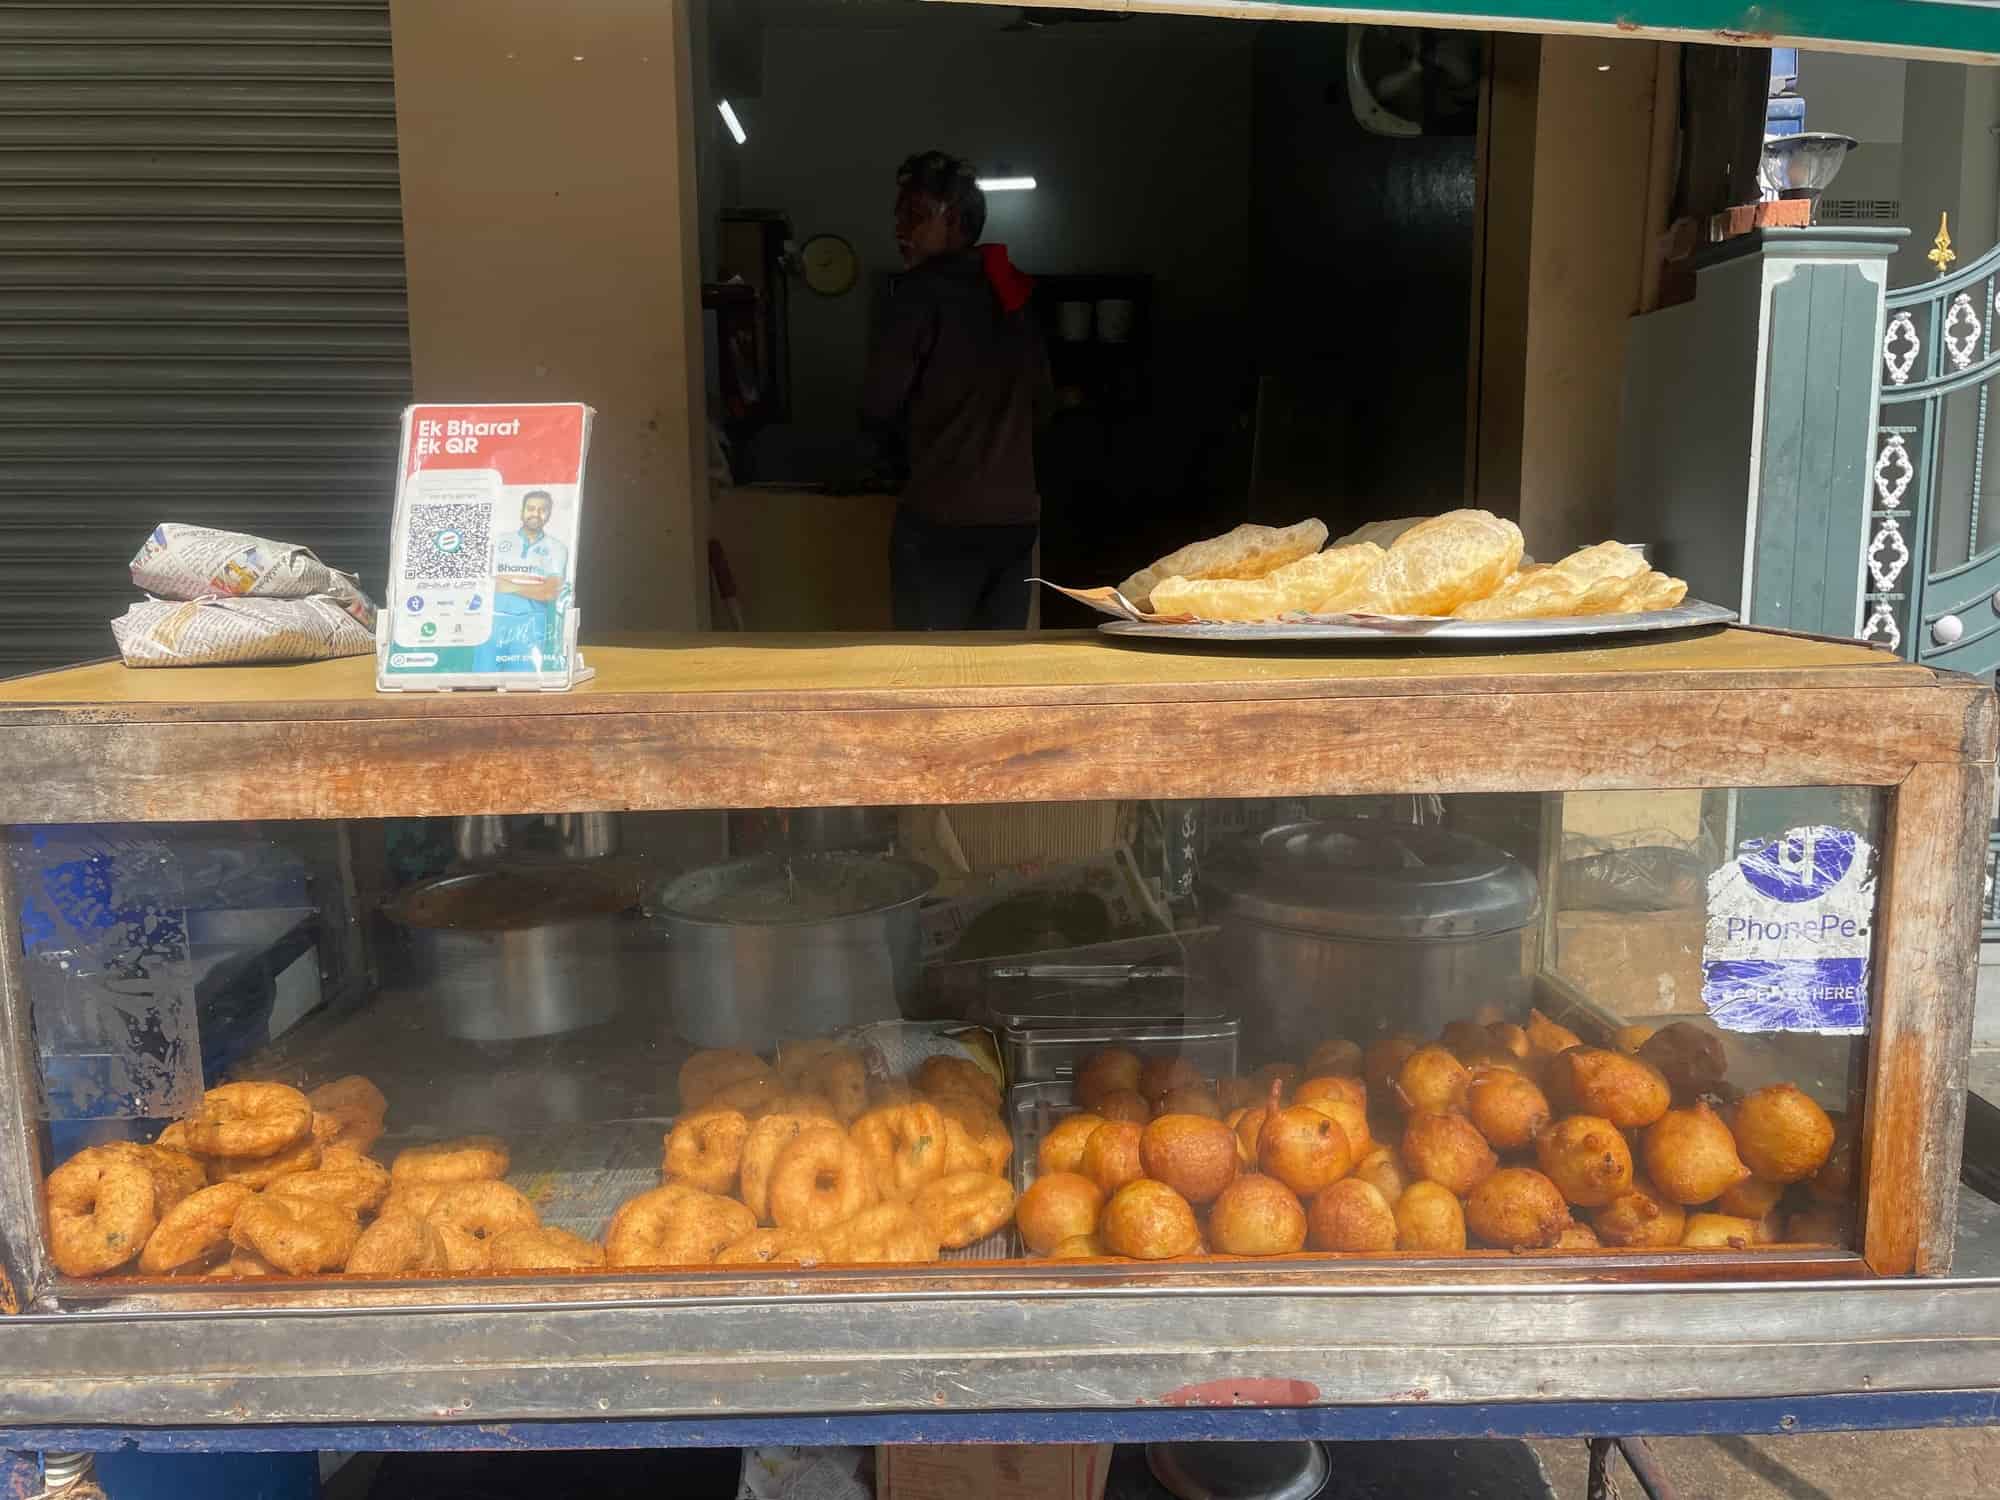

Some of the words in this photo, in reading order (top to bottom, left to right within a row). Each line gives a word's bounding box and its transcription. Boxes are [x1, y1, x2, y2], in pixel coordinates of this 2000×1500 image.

[419, 420, 442, 436] Ek
[447, 418, 520, 436] Bharat
[417, 437, 441, 454] Ek
[445, 437, 478, 454] QR
[1727, 914, 1857, 941] PhonePe
[1812, 985, 1855, 1001] HERE
